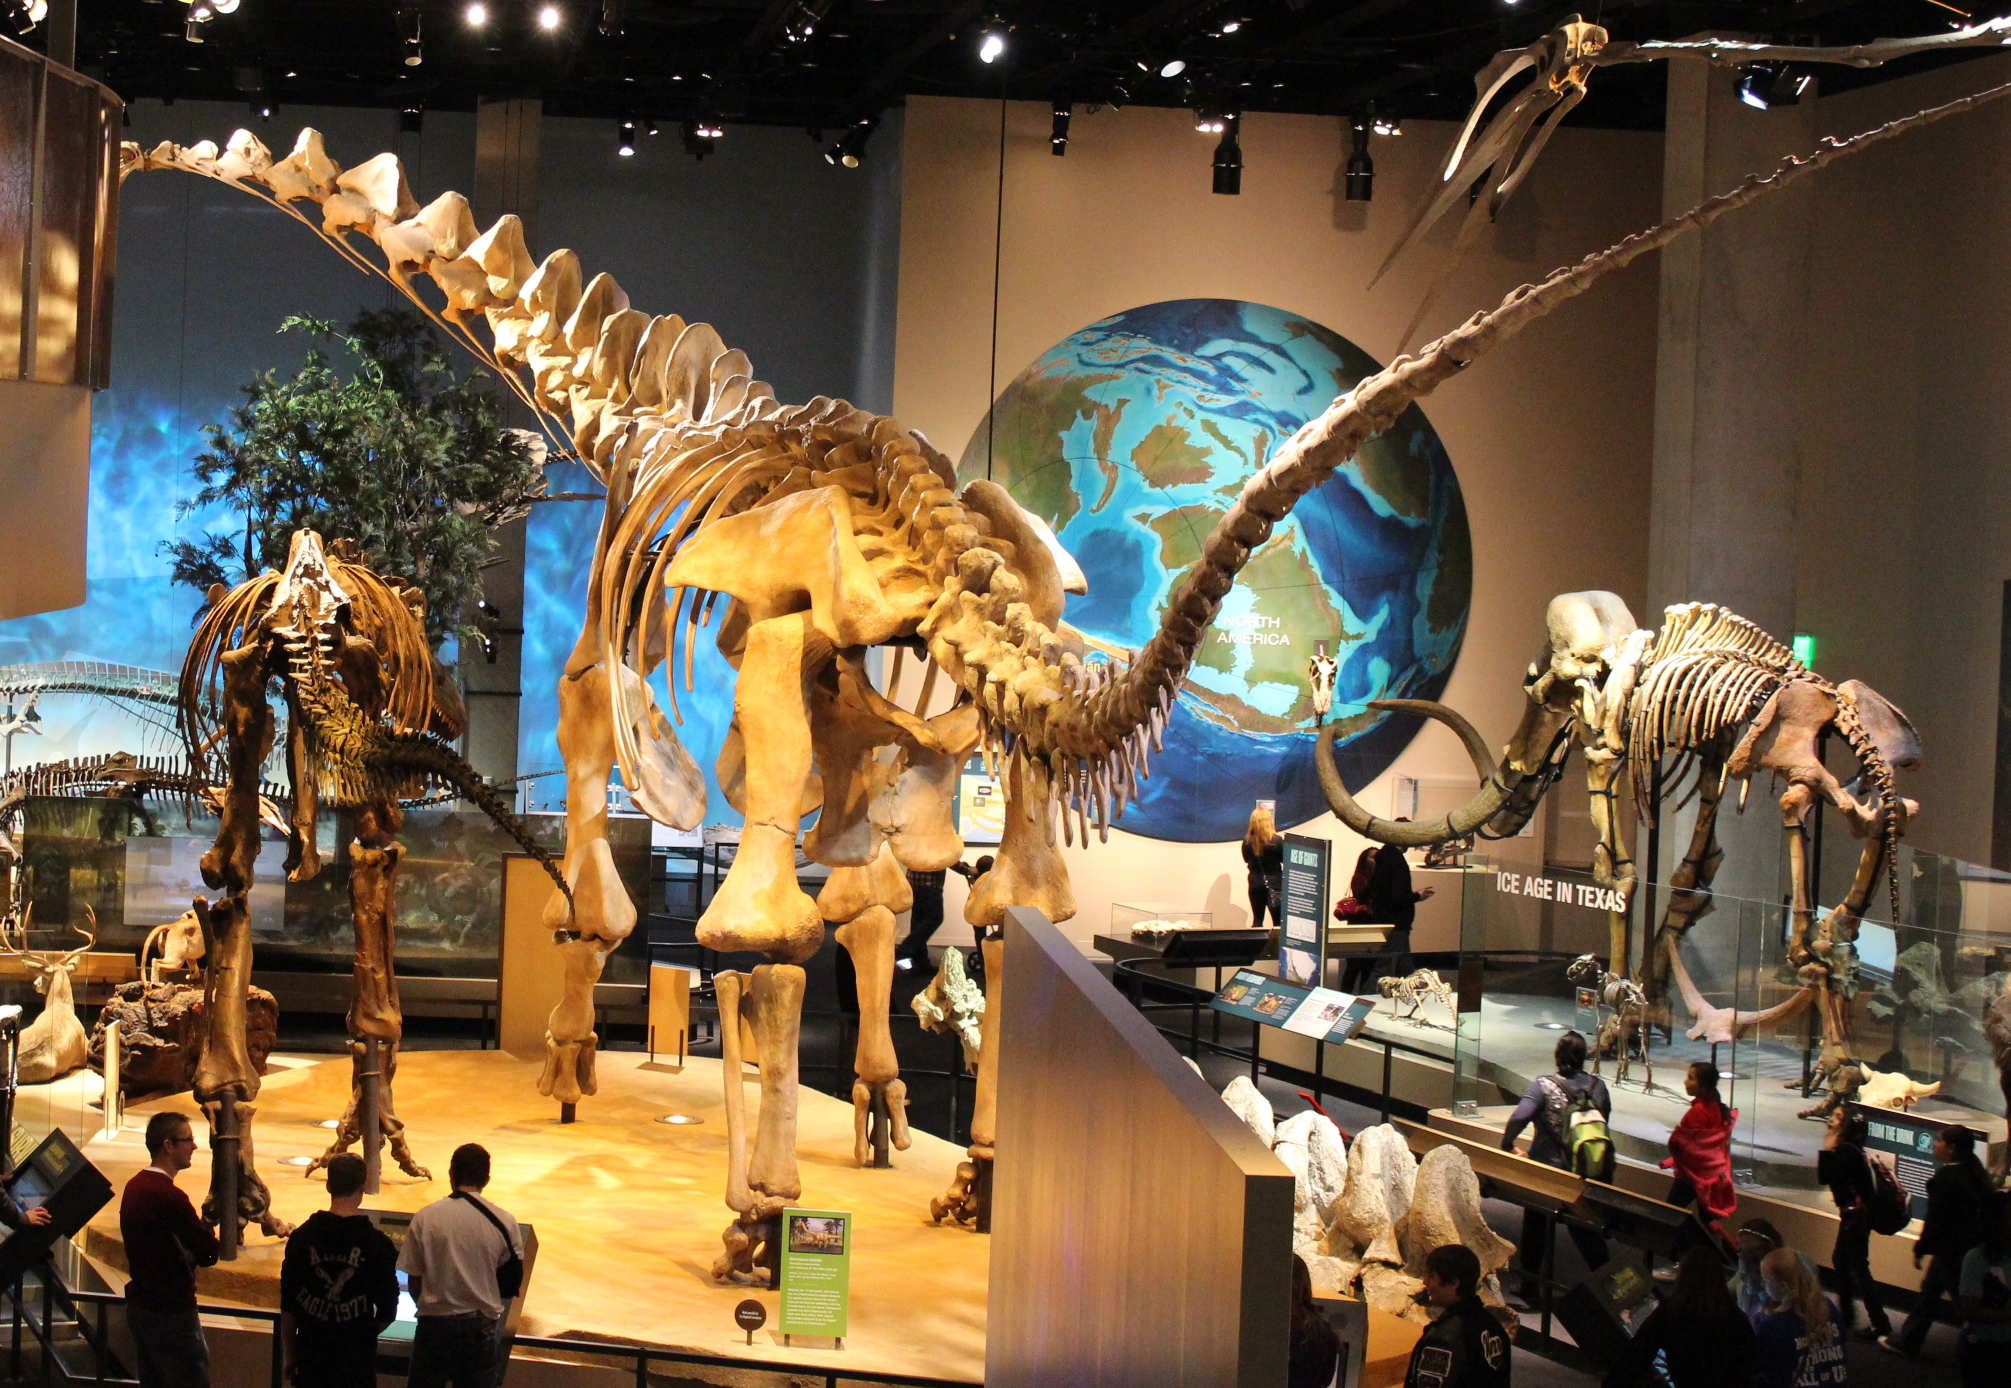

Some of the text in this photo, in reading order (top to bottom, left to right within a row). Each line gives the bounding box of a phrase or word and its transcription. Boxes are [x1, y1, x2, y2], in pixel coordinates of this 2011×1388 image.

[1223, 615, 1280, 629] NORTH
[1216, 632, 1291, 646] AMERICA
[1496, 871, 1626, 913] ICE AGE IN TEXAS
[295, 1286, 368, 1323] EAGLE 1977
